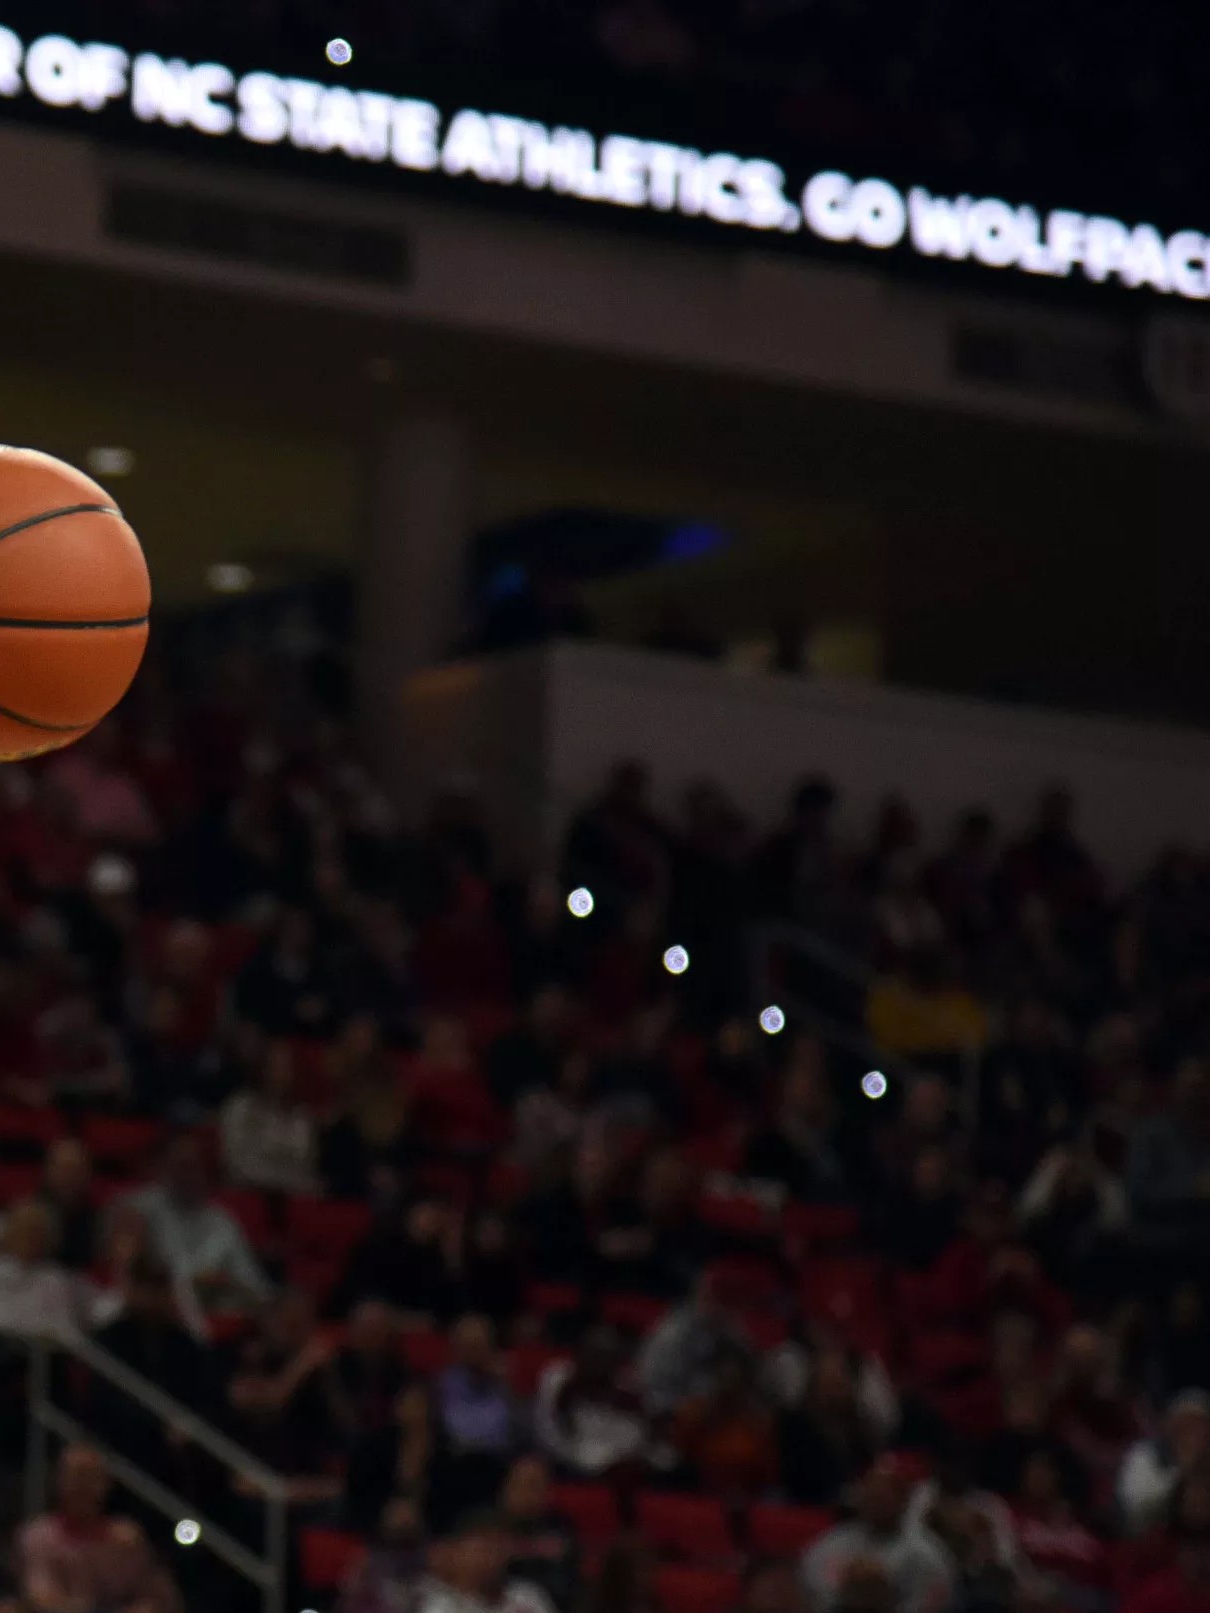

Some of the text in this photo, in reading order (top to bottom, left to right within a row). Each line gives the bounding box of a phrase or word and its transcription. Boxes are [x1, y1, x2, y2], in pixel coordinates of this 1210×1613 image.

[26, 36, 127, 108] OF
[132, 54, 234, 133] NC
[237, 72, 438, 169] STATE
[803, 172, 906, 247] GO
[907, 188, 1210, 298] WOLFPAC
